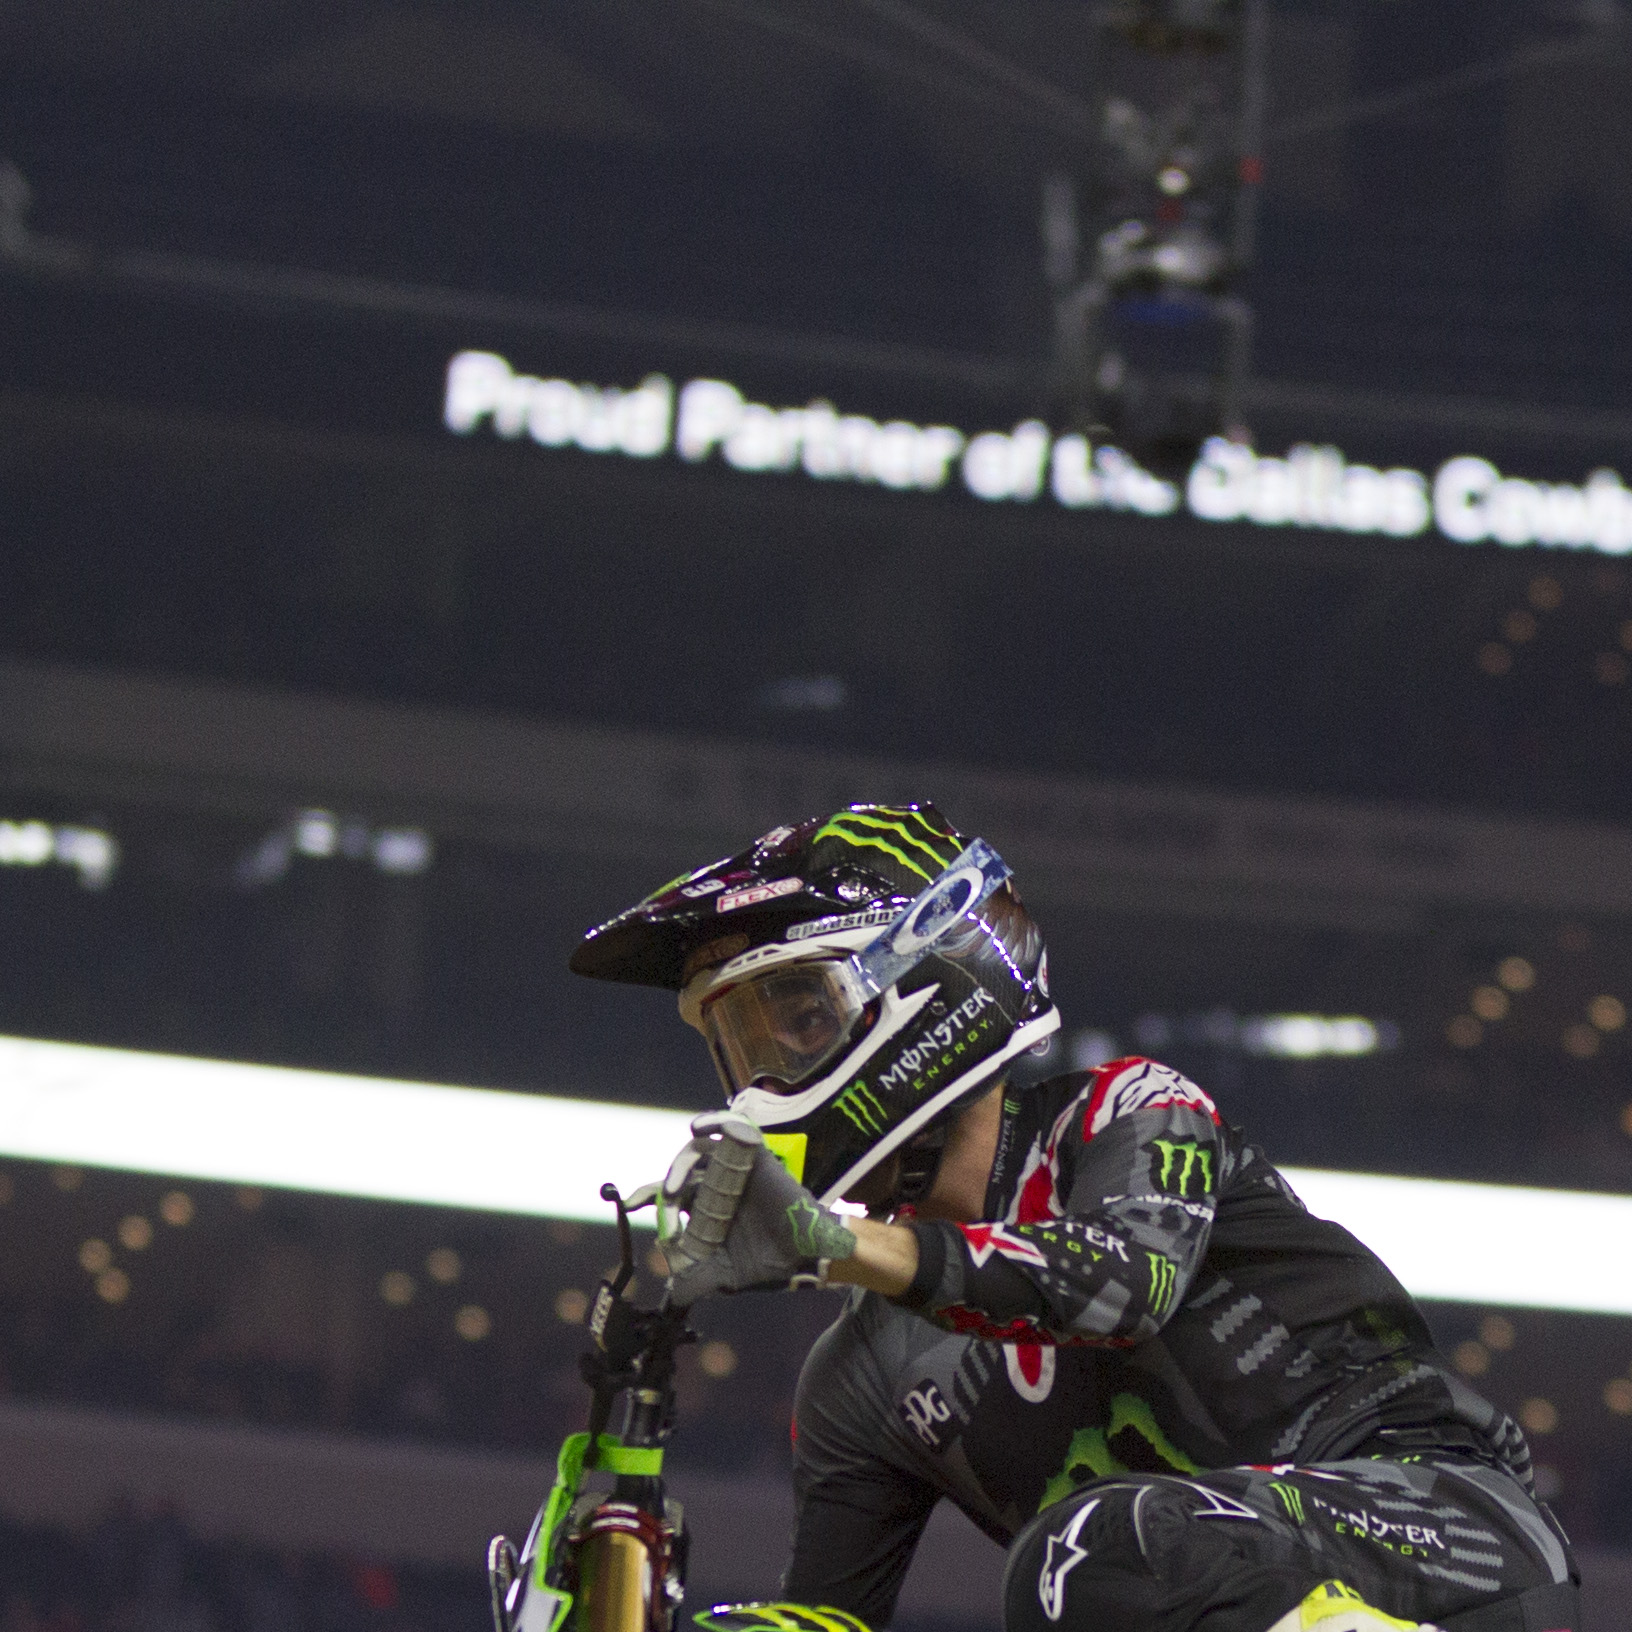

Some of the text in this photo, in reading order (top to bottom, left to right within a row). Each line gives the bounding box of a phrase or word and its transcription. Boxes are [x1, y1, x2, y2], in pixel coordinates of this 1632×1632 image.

[444, 350, 673, 457] Proud
[676, 378, 962, 492] Partner
[966, 419, 1050, 500] of
[1186, 435, 1429, 537] Dallas
[879, 986, 994, 1090] MONSTER
[913, 1019, 989, 1090] ENERGY
